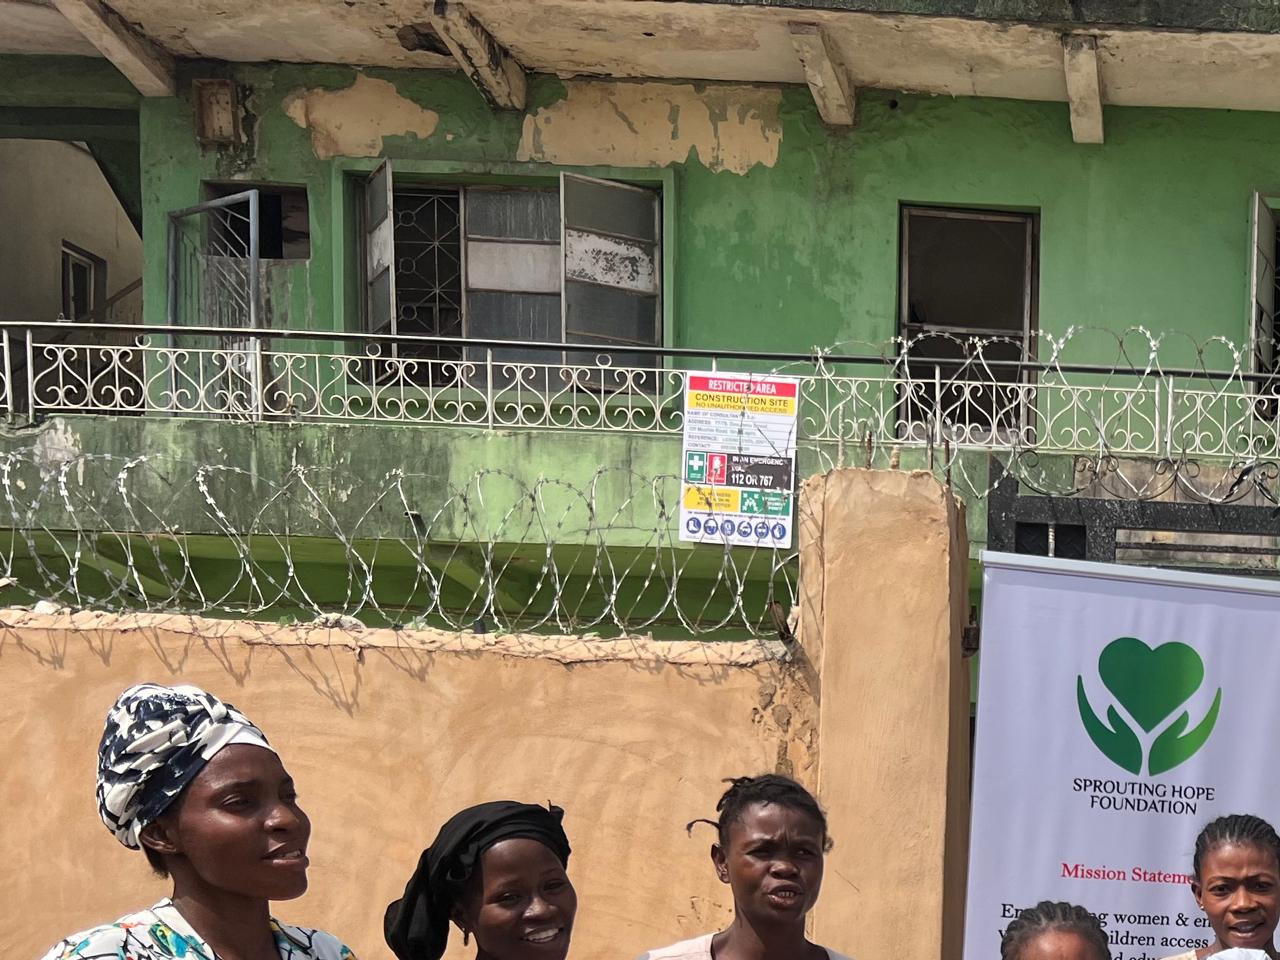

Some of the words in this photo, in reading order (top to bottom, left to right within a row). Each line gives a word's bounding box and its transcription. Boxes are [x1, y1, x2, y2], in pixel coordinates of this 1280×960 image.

[708, 380, 753, 393] RESTRICTED
[755, 383, 777, 394] AREA
[695, 393, 767, 405] CONSTRUCTION
[769, 399, 789, 407] SITE
[707, 403, 760, 412] UNAUTHORED
[750, 457, 786, 466] EMERGENC
[731, 474, 744, 484] 112
[745, 475, 758, 485] OR
[759, 476, 773, 487] 767
[1072, 778, 1167, 797] SPROUTING
[1171, 785, 1215, 800] HOPE
[1090, 795, 1197, 815] FOUNDATION
[1061, 863, 1126, 880] Mission
[1131, 867, 1194, 884] Stateme
[1113, 913, 1170, 927] women
[1175, 912, 1189, 927] &
[1108, 930, 1155, 946] ildren
[1160, 935, 1209, 948] access
